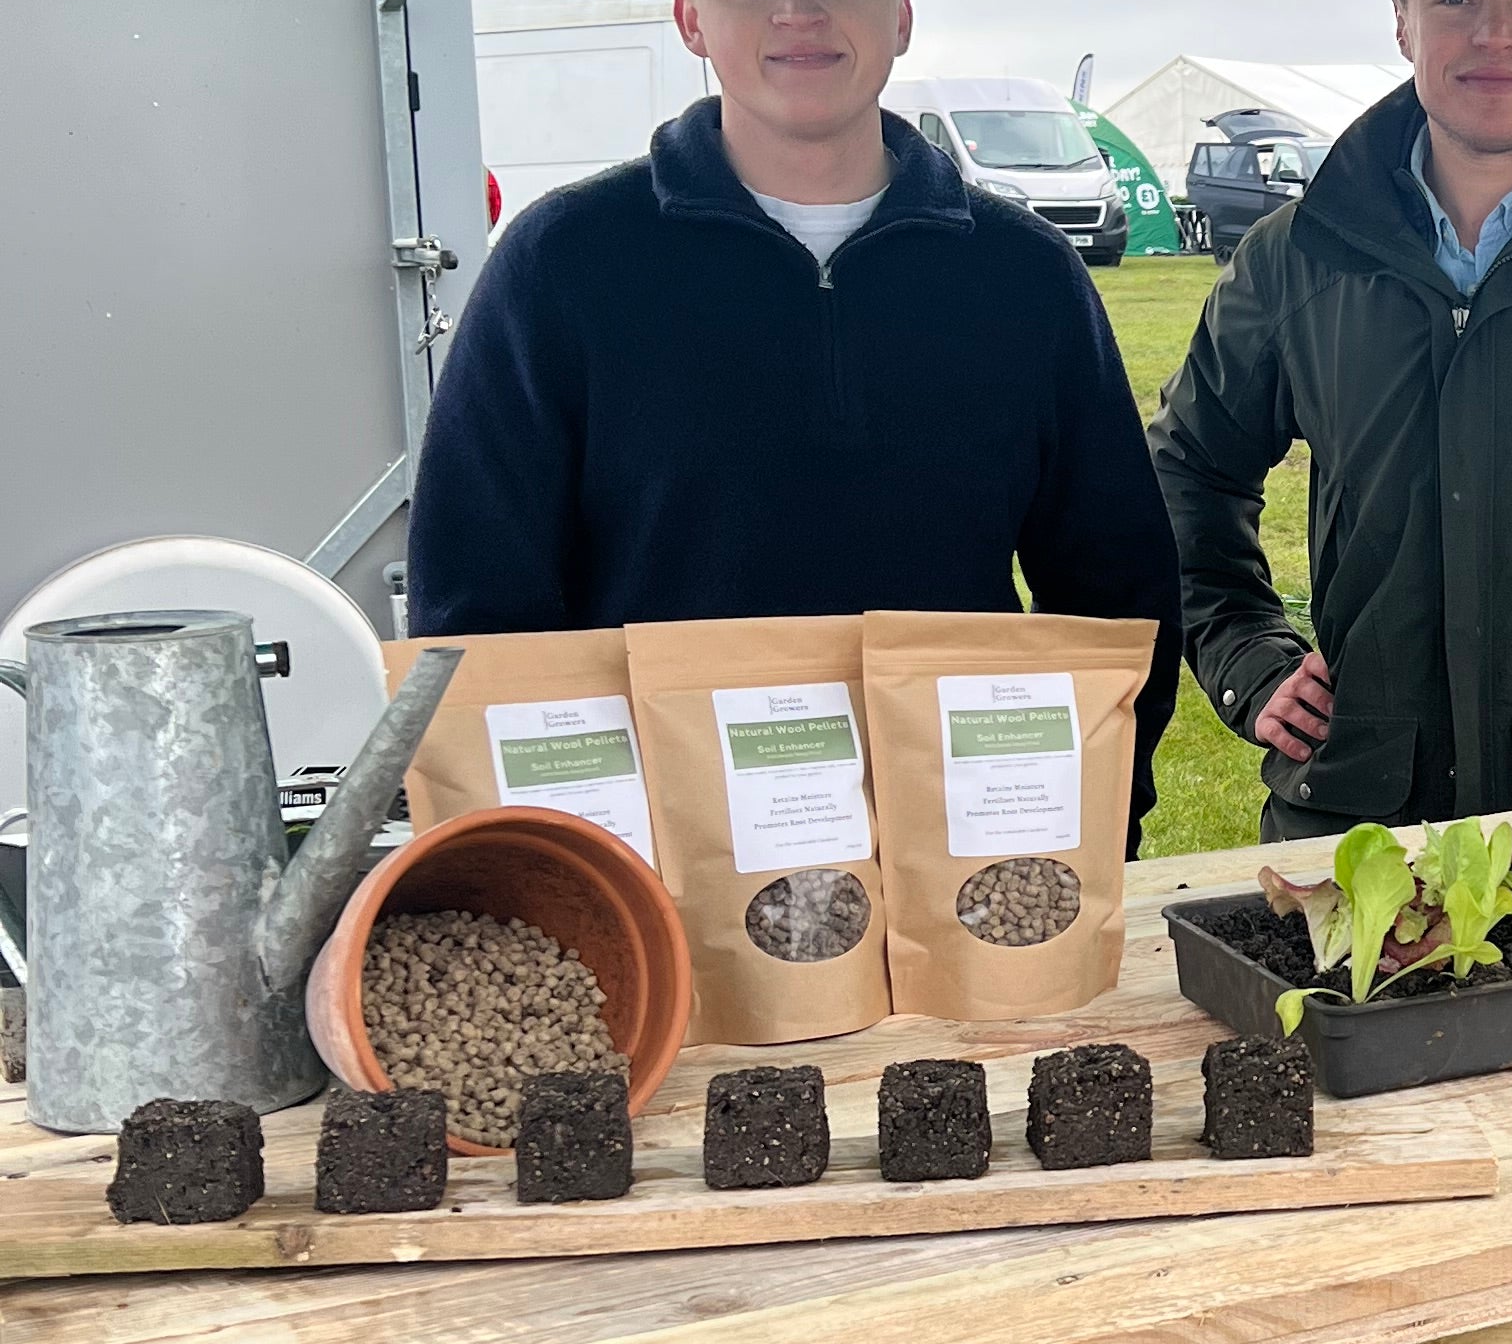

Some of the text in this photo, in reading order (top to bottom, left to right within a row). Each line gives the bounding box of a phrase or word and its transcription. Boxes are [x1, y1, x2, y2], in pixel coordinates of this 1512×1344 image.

[951, 710, 1069, 725] Natural Wool Pellets
[729, 720, 849, 738] Natural Wool Pellets
[502, 734, 628, 755] Natural Wool Pellets
[976, 731, 1044, 743] Soil Enhancer
[756, 740, 826, 754] Soil Enhancer
[531, 761, 551, 772] Soil
[555, 757, 603, 770] Enhancer
[280, 790, 322, 805] lliams
